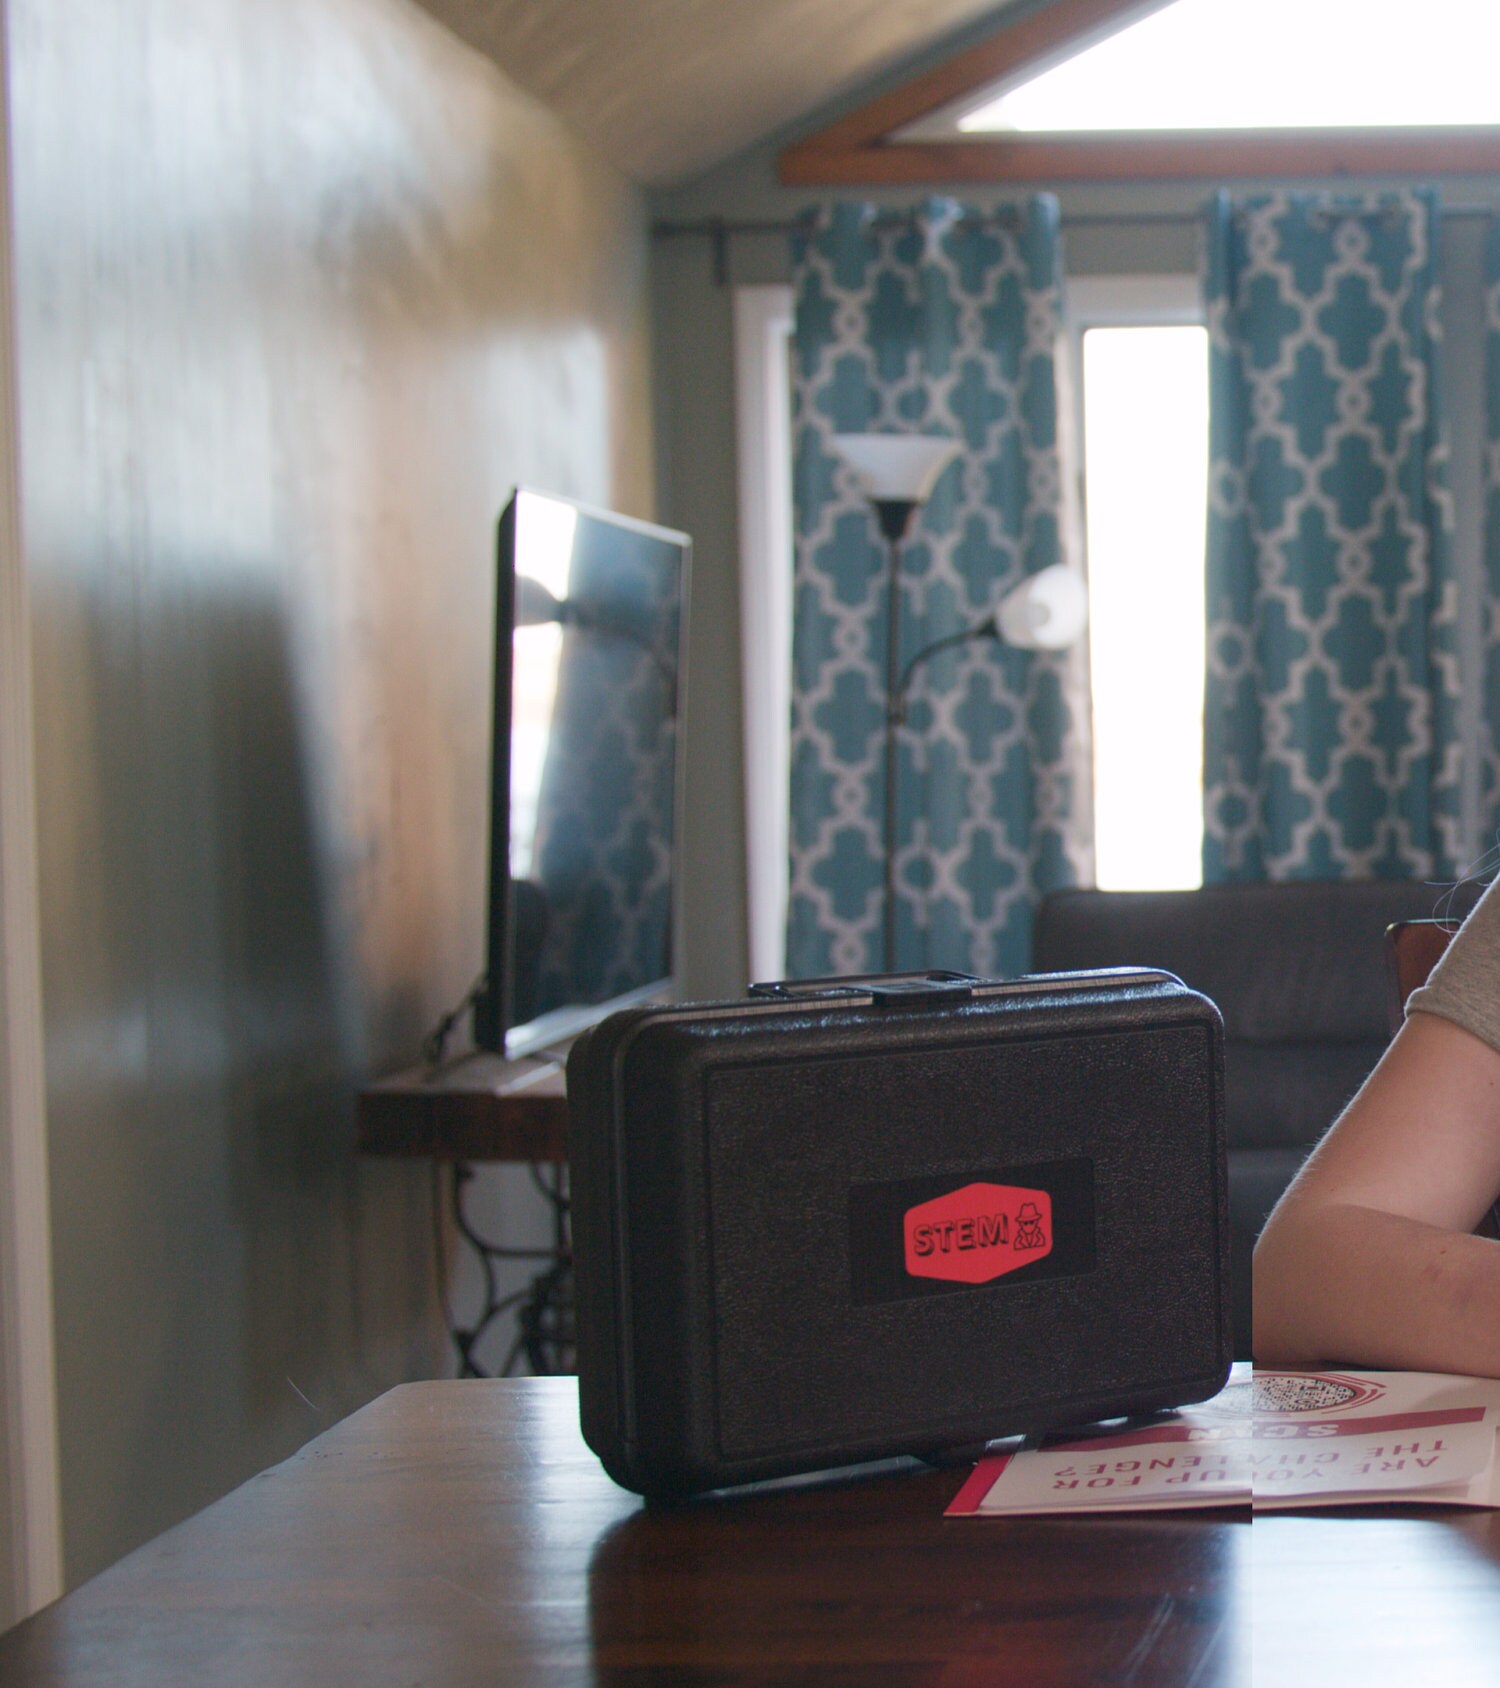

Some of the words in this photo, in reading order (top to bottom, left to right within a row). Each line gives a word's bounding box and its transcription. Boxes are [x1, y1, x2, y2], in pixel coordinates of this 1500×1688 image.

[913, 1213, 1010, 1256] STEM
[1187, 1423, 1339, 1442] SCN
[1362, 1440, 1448, 1459] THE
[1053, 1452, 1341, 1476] CHALENGE?
[1350, 1455, 1440, 1475] ARE
[1052, 1475, 1142, 1489] FOR
[1165, 1469, 1227, 1484] UP
